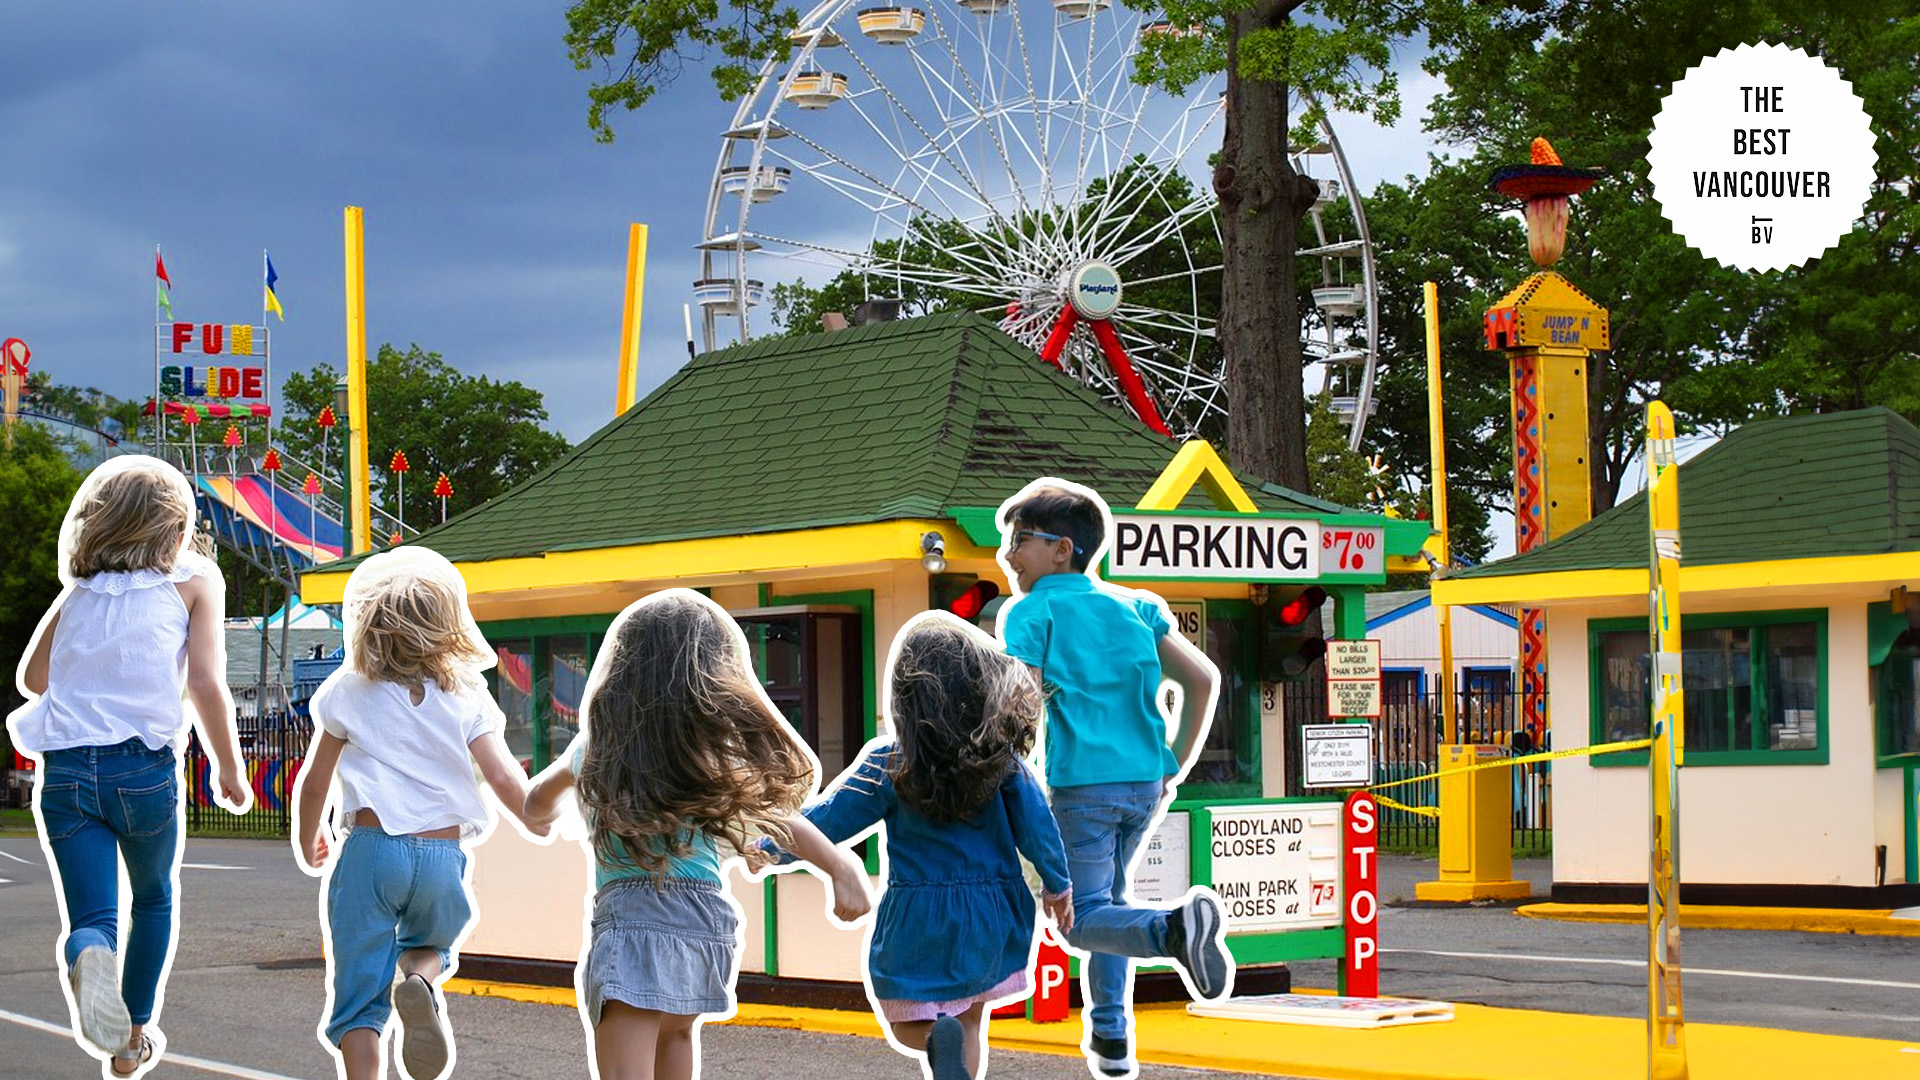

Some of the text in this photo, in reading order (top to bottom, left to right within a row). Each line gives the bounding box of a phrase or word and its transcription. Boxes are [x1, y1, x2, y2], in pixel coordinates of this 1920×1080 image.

[1079, 283, 1118, 295] Playland
[172, 322, 253, 356] FUN
[1551, 329, 1579, 344] BEAN
[160, 366, 263, 399] SLIDE
[1116, 522, 1308, 570] PARKING
[1172, 611, 1199, 633] NS
[1336, 645, 1368, 653] NO BILLS
[1339, 656, 1367, 664] LARGER
[1332, 667, 1350, 675] THAN
[1264, 690, 1275, 711] 3
[1337, 691, 1371, 699] FOR YOUR
[1212, 818, 1303, 836] KIDDYLAND
[1212, 838, 1302, 857] CLOSES at
[1258, 878, 1298, 896] PARK
[1350, 799, 1376, 969] STOP
[1285, 902, 1299, 914] at
